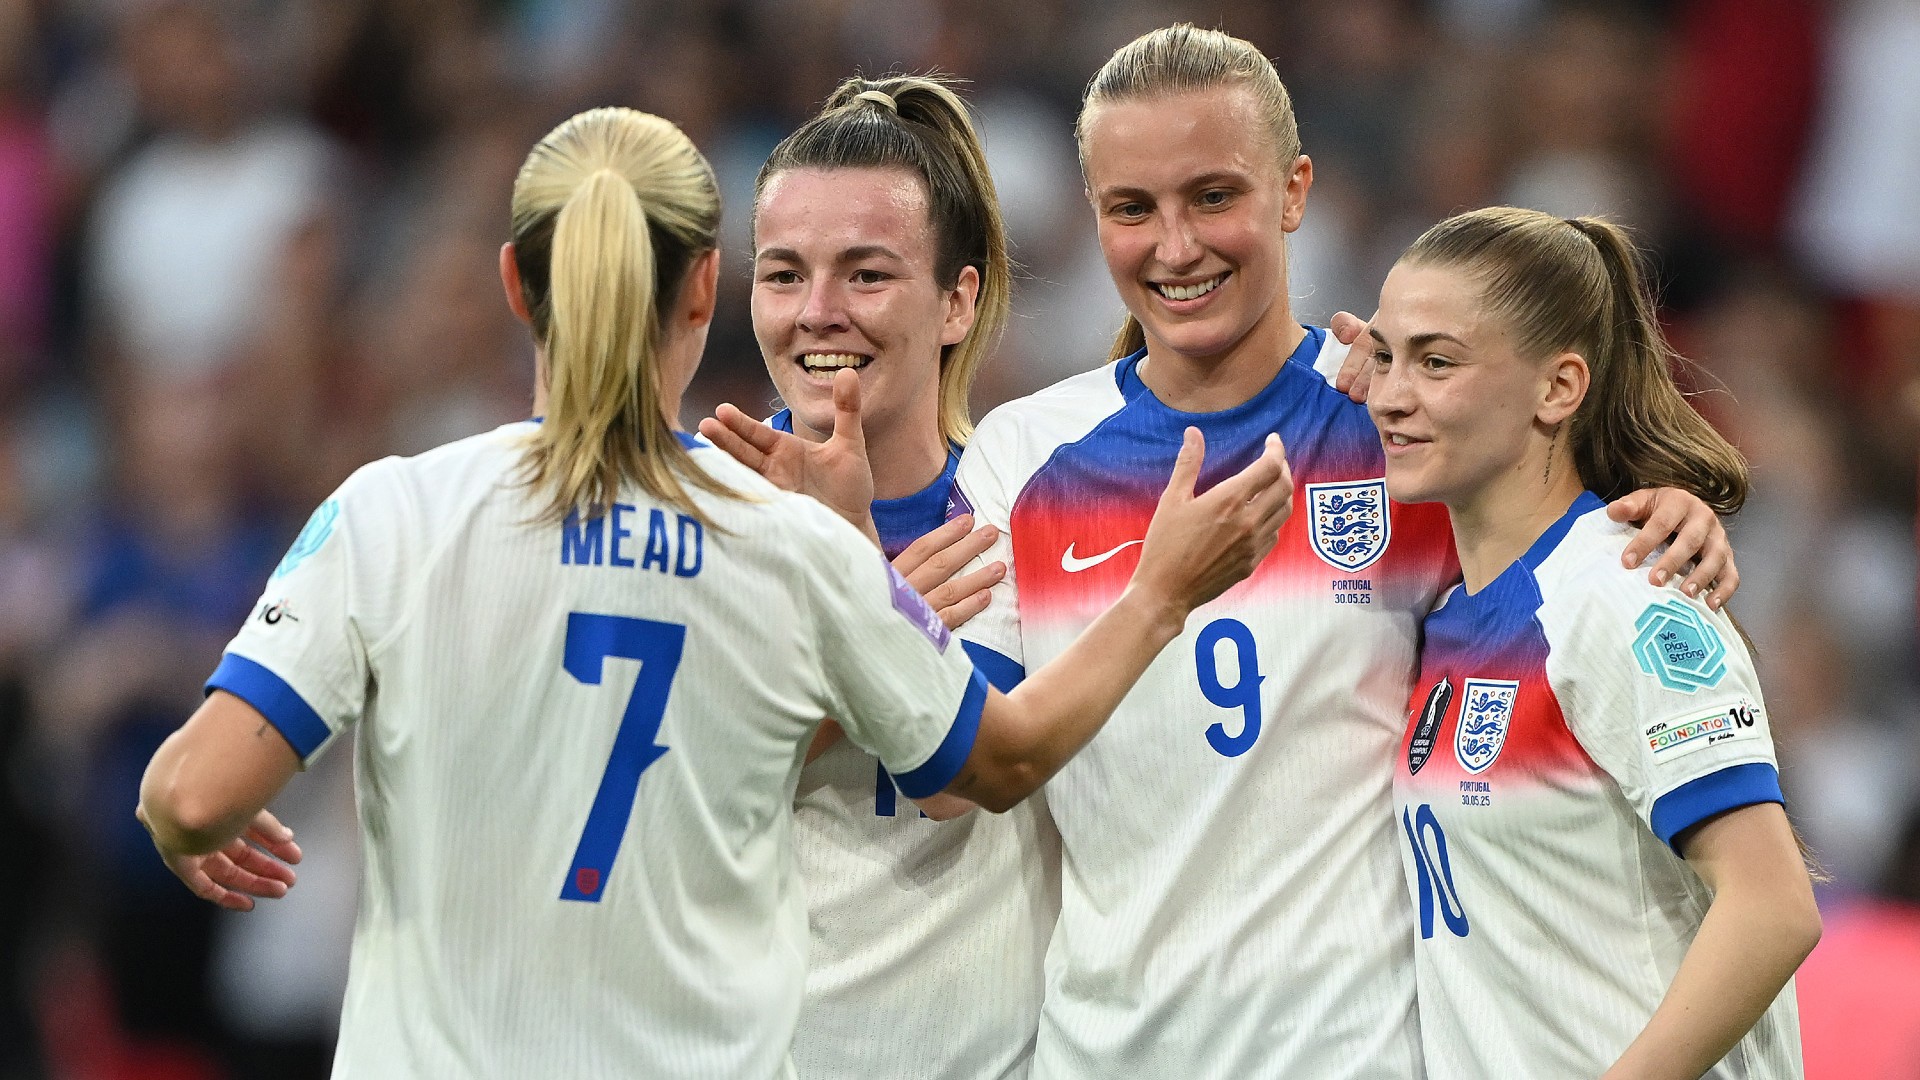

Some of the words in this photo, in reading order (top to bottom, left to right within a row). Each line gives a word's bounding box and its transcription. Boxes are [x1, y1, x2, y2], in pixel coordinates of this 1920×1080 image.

[561, 494, 704, 579] MEAD
[1332, 579, 1373, 591] PORTUGAL
[1334, 593, 1371, 604] 30.05.25
[1659, 631, 1677, 641] We
[1669, 649, 1706, 663] Strong
[1194, 617, 1266, 758] 9
[1645, 722, 1668, 736] UEFA
[559, 611, 687, 903] 7
[1460, 780, 1491, 792] PORTUGAL
[1461, 794, 1491, 807] 30.05.25
[1402, 803, 1470, 940] 10
